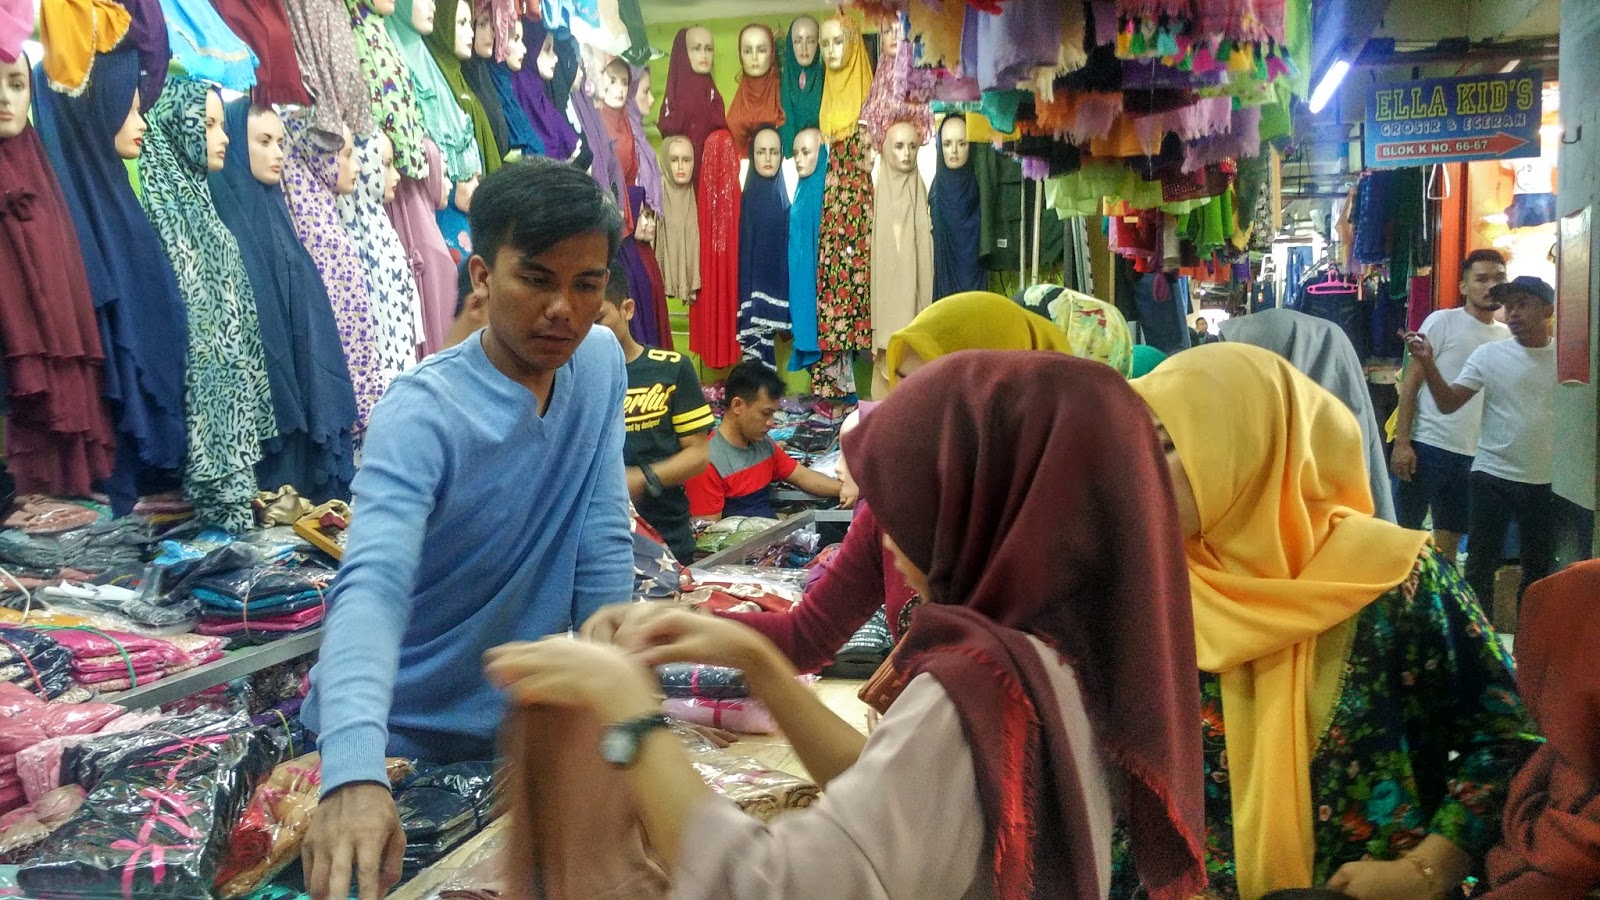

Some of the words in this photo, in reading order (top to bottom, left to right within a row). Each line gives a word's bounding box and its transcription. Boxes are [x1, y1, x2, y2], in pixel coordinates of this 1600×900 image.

[1375, 86, 1448, 121] ELLA
[1456, 77, 1534, 115] KID'S
[1380, 120, 1441, 137] GROSIR
[1447, 119, 1457, 131] &
[1463, 114, 1526, 131] ECERAN
[1382, 143, 1415, 157] BLOK
[1418, 143, 1427, 154] K
[1431, 142, 1452, 153] NO.
[1455, 140, 1488, 152] 66-67
[624, 384, 676, 414] erful
